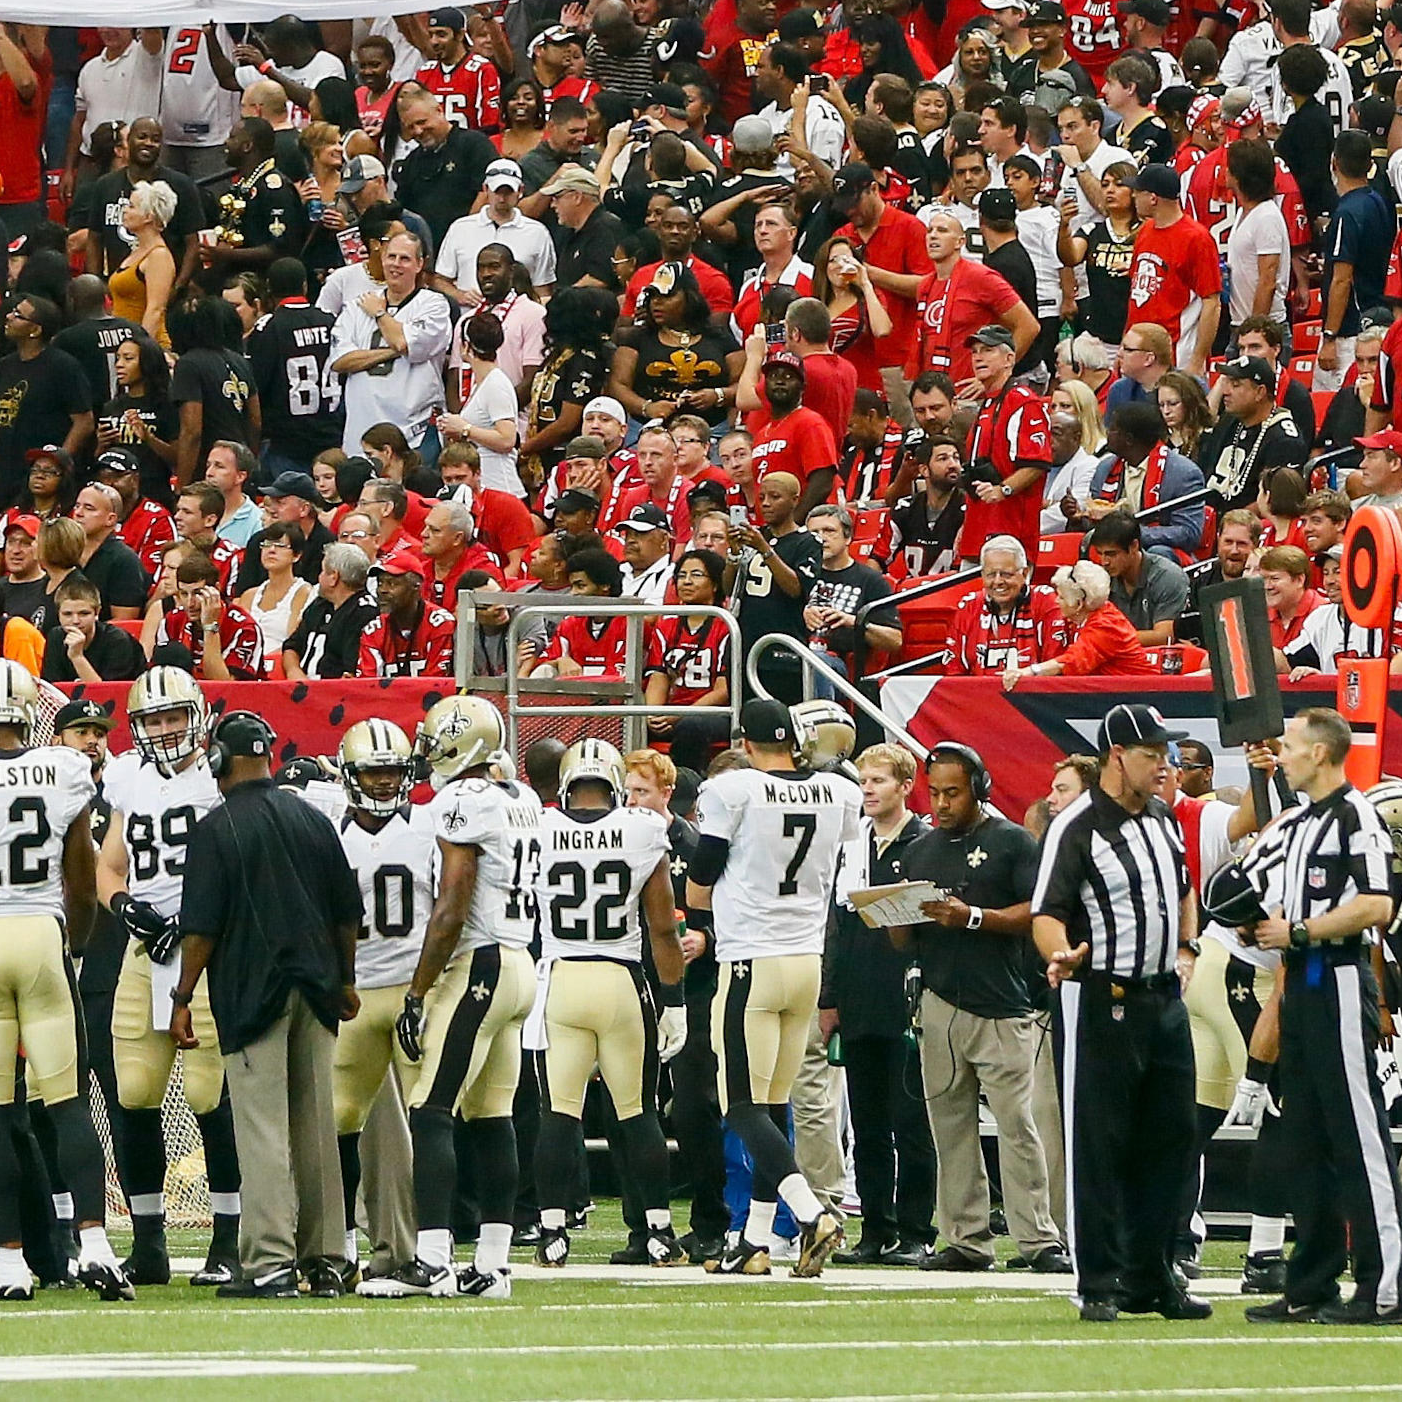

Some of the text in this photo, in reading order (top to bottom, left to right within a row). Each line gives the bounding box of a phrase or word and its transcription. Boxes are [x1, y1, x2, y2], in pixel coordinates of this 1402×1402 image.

[168, 28, 201, 76] 2
[1070, 15, 1121, 52] 84
[293, 327, 330, 347] WHITE
[286, 354, 341, 416] 84
[764, 781, 835, 806] McCOWN
[125, 804, 200, 881] 89
[552, 828, 624, 850] INGRAM
[782, 812, 818, 897] 7
[547, 860, 632, 941] 22
